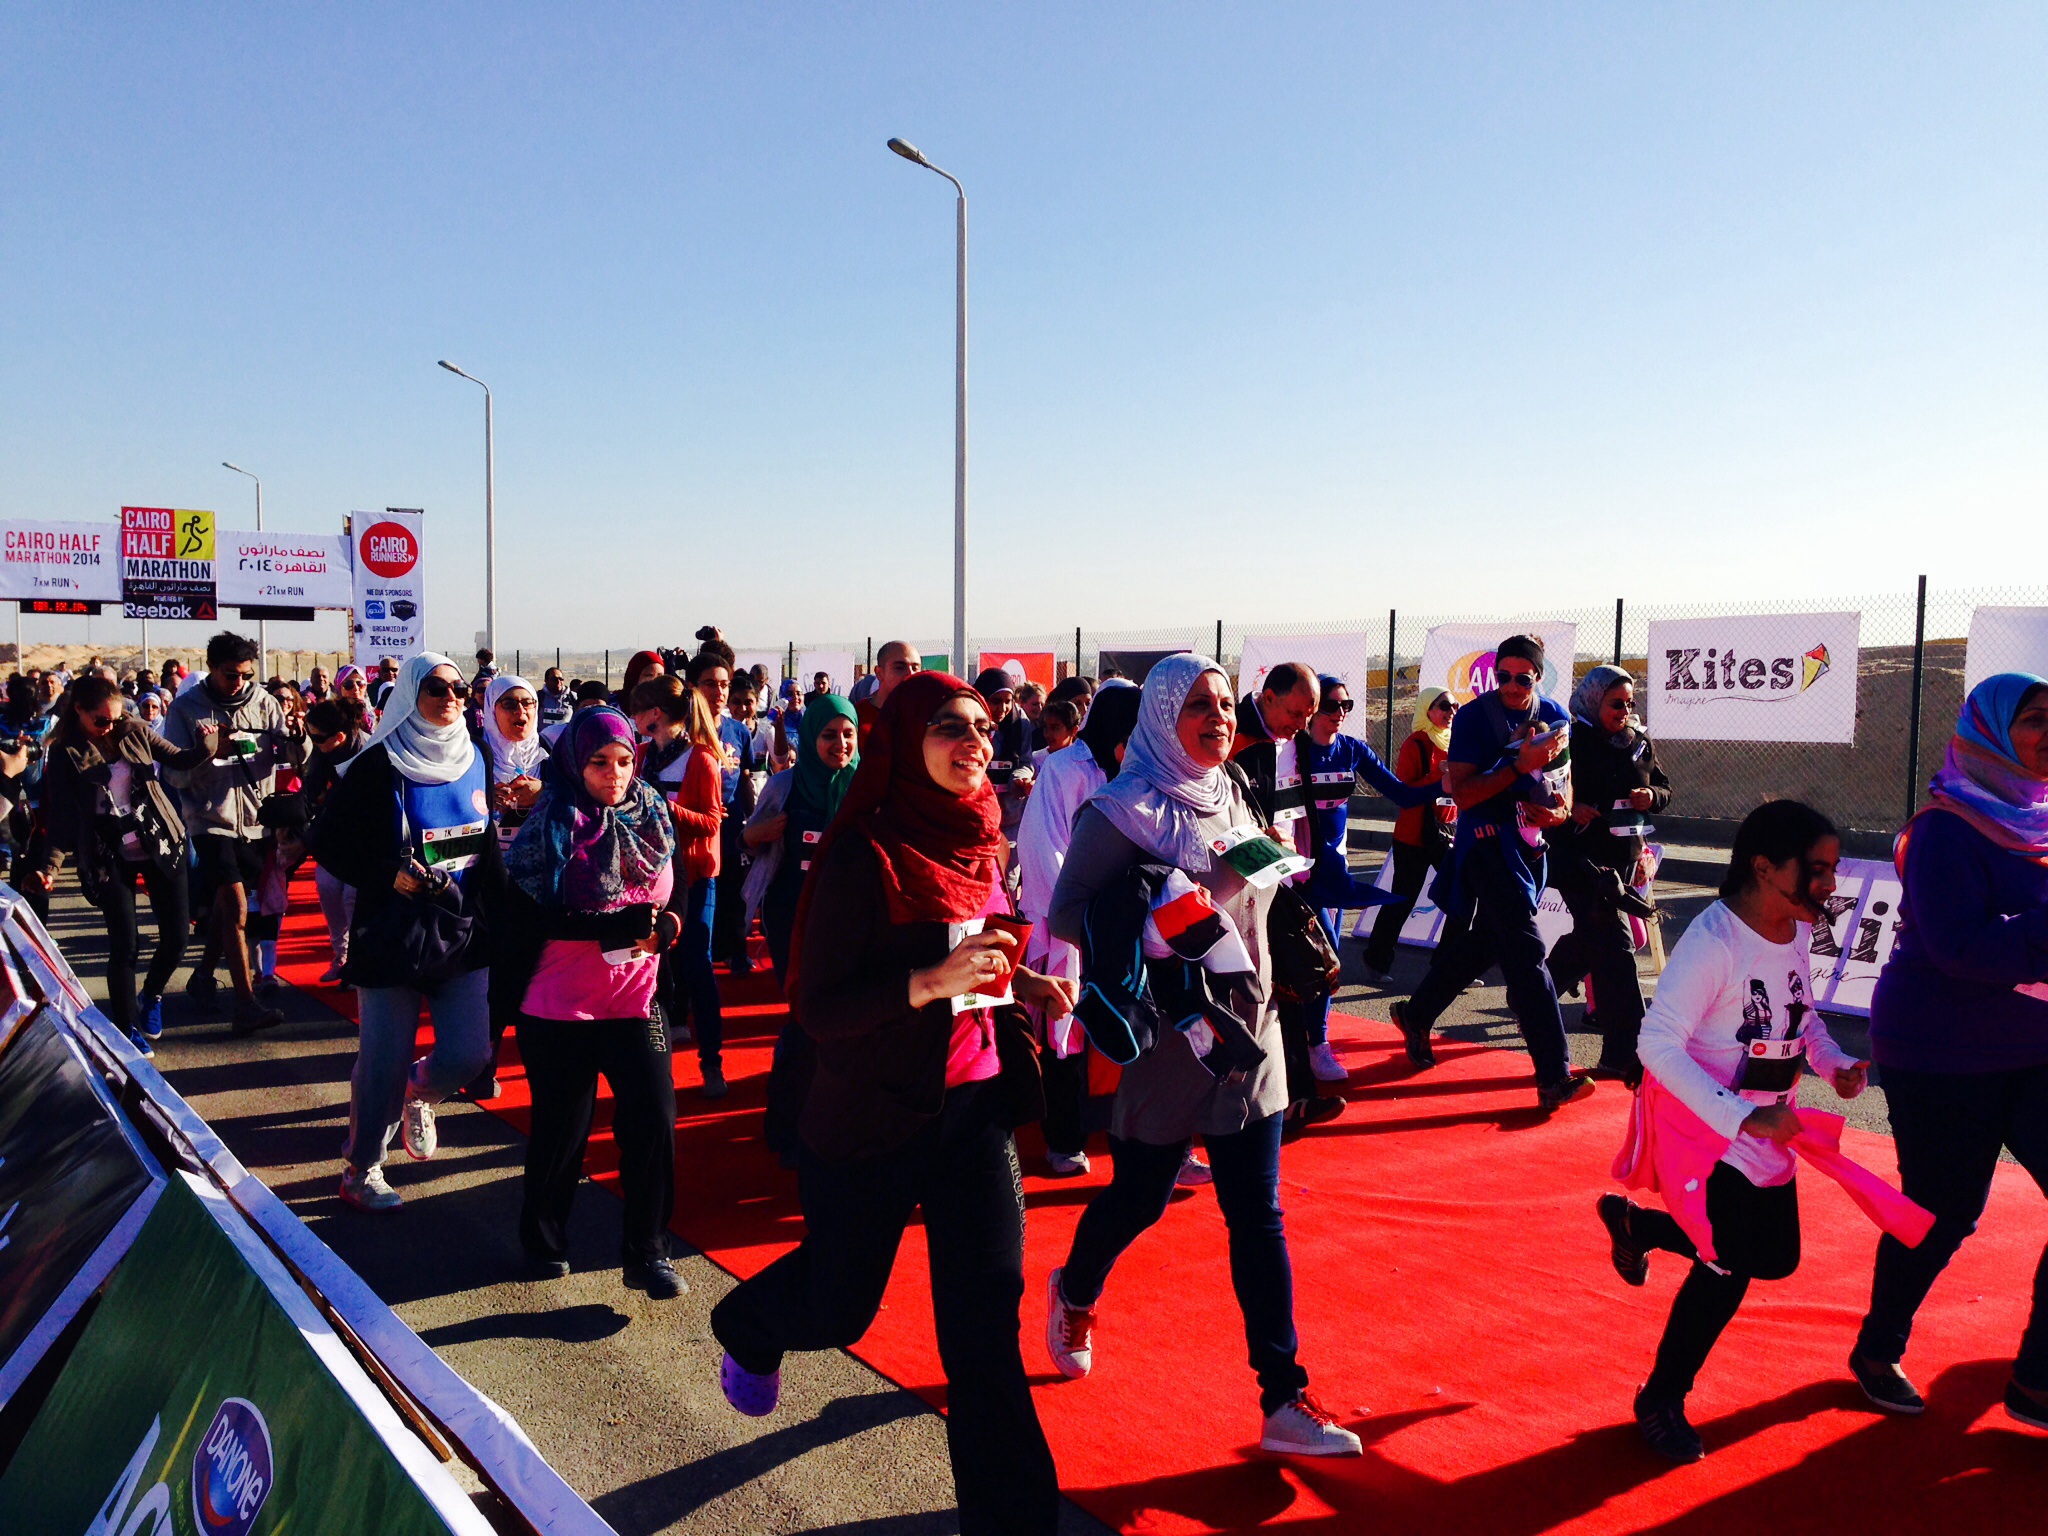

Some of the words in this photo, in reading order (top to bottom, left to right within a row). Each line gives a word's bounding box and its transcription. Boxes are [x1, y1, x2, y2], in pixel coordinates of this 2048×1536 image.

[125, 510, 170, 530] CAIRO
[6, 531, 55, 550] CAIRO
[60, 533, 101, 551] HALF
[126, 533, 171, 556] HALF
[370, 536, 408, 552] CAIRO
[238, 542, 287, 557] ماراثون
[290, 545, 325, 557] نصف
[5, 550, 70, 564] MARATHON
[73, 553, 100, 565] 2014
[371, 552, 408, 563] RUNNERS
[127, 559, 211, 579] MARATHON
[239, 559, 271, 571] ٢٠١٤
[275, 561, 326, 573] القاهرة
[52, 578, 70, 587] RUN
[190, 583, 211, 592] نصف
[288, 587, 304, 596] RUN
[123, 602, 191, 618] Reebok
[370, 636, 406, 646] Kites
[1665, 648, 1794, 690] Kites
[444, 829, 453, 838] 1K
[1232, 829, 1247, 841] 1K
[1781, 1043, 1792, 1057] 1K
